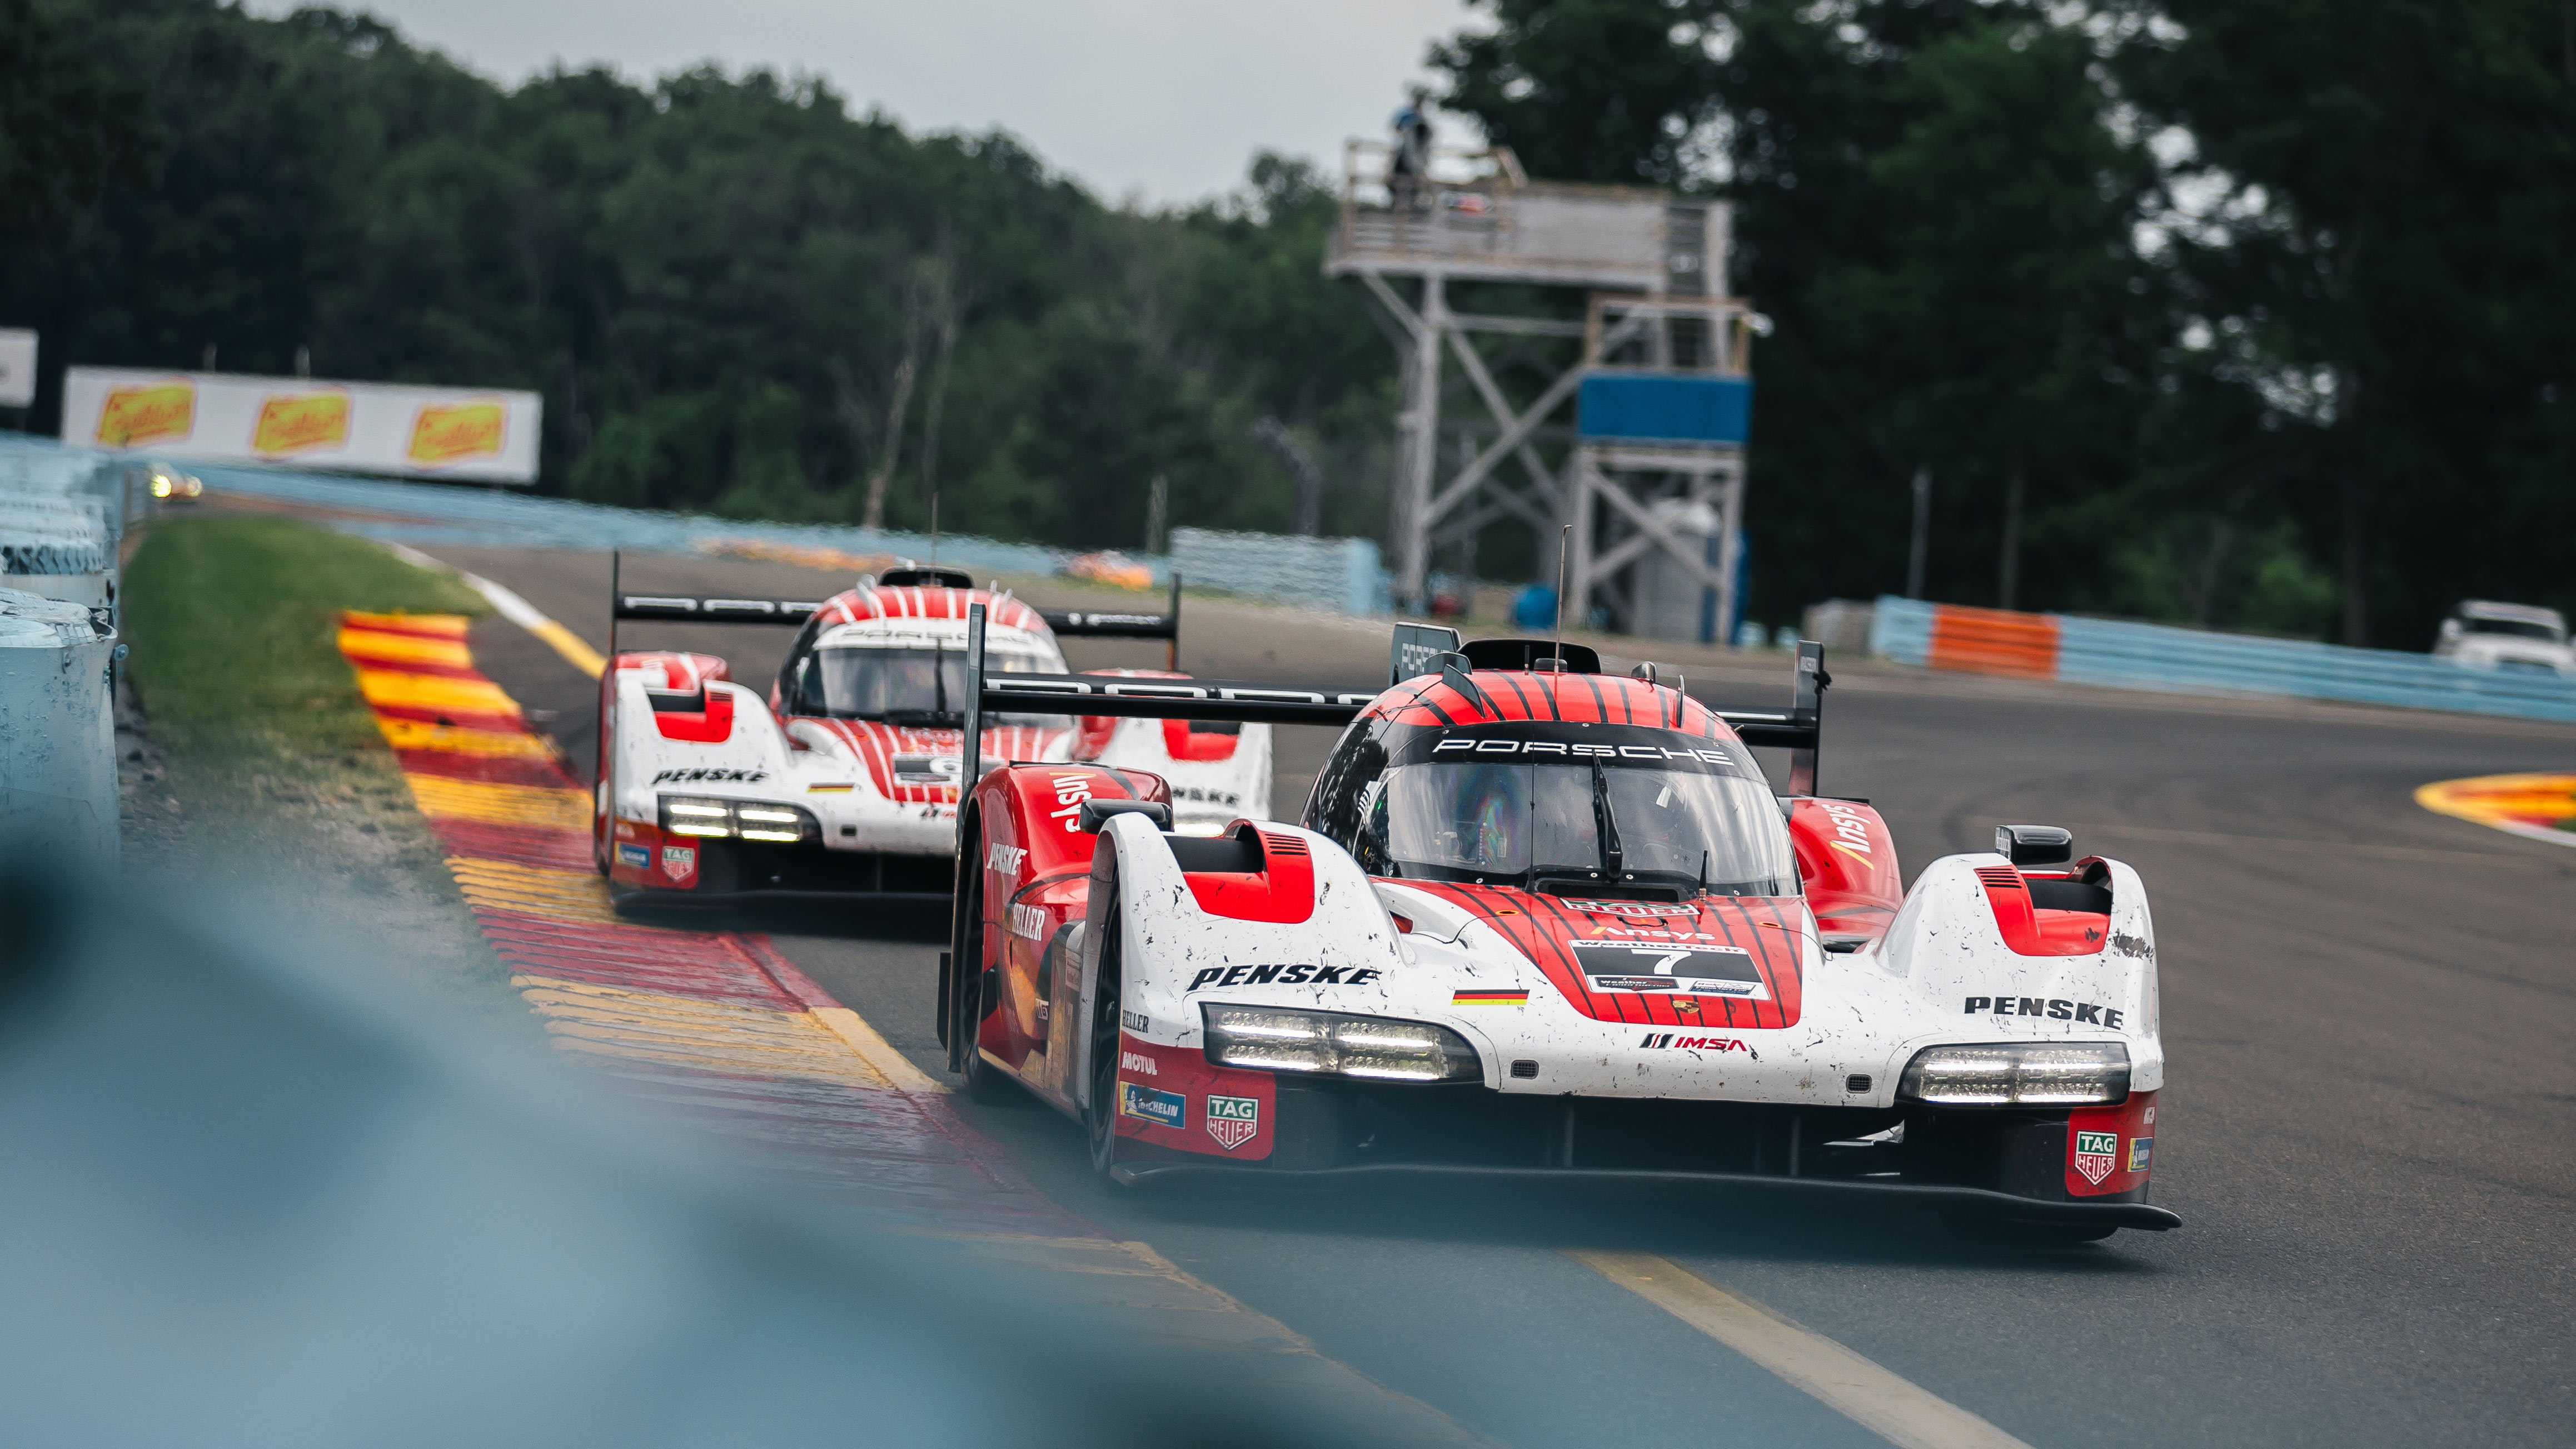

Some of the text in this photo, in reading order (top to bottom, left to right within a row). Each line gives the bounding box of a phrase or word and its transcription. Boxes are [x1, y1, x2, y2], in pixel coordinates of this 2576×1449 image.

[1432, 739, 1735, 766] PORSCHE
[651, 768, 770, 785] PENSKE
[1821, 803, 1874, 870] Ansys
[666, 848, 690, 860] TAG
[986, 842, 1028, 877] PENSKE
[1012, 902, 1047, 942] HELLER
[1590, 926, 1716, 940] Ansys
[1630, 948, 1692, 975] 7
[1185, 963, 1383, 992] PENSKE
[1122, 1009, 1149, 1034] HELLER
[1964, 996, 2124, 1030] PENSKE
[1675, 1035, 1747, 1052] IMSA
[1122, 1050, 1158, 1076] MOTUL
[1211, 1099, 1253, 1118] TAG
[1209, 1120, 1255, 1146] HEUER
[2081, 1136, 2114, 1153] TAG
[2078, 1155, 2113, 1181] HEUER
